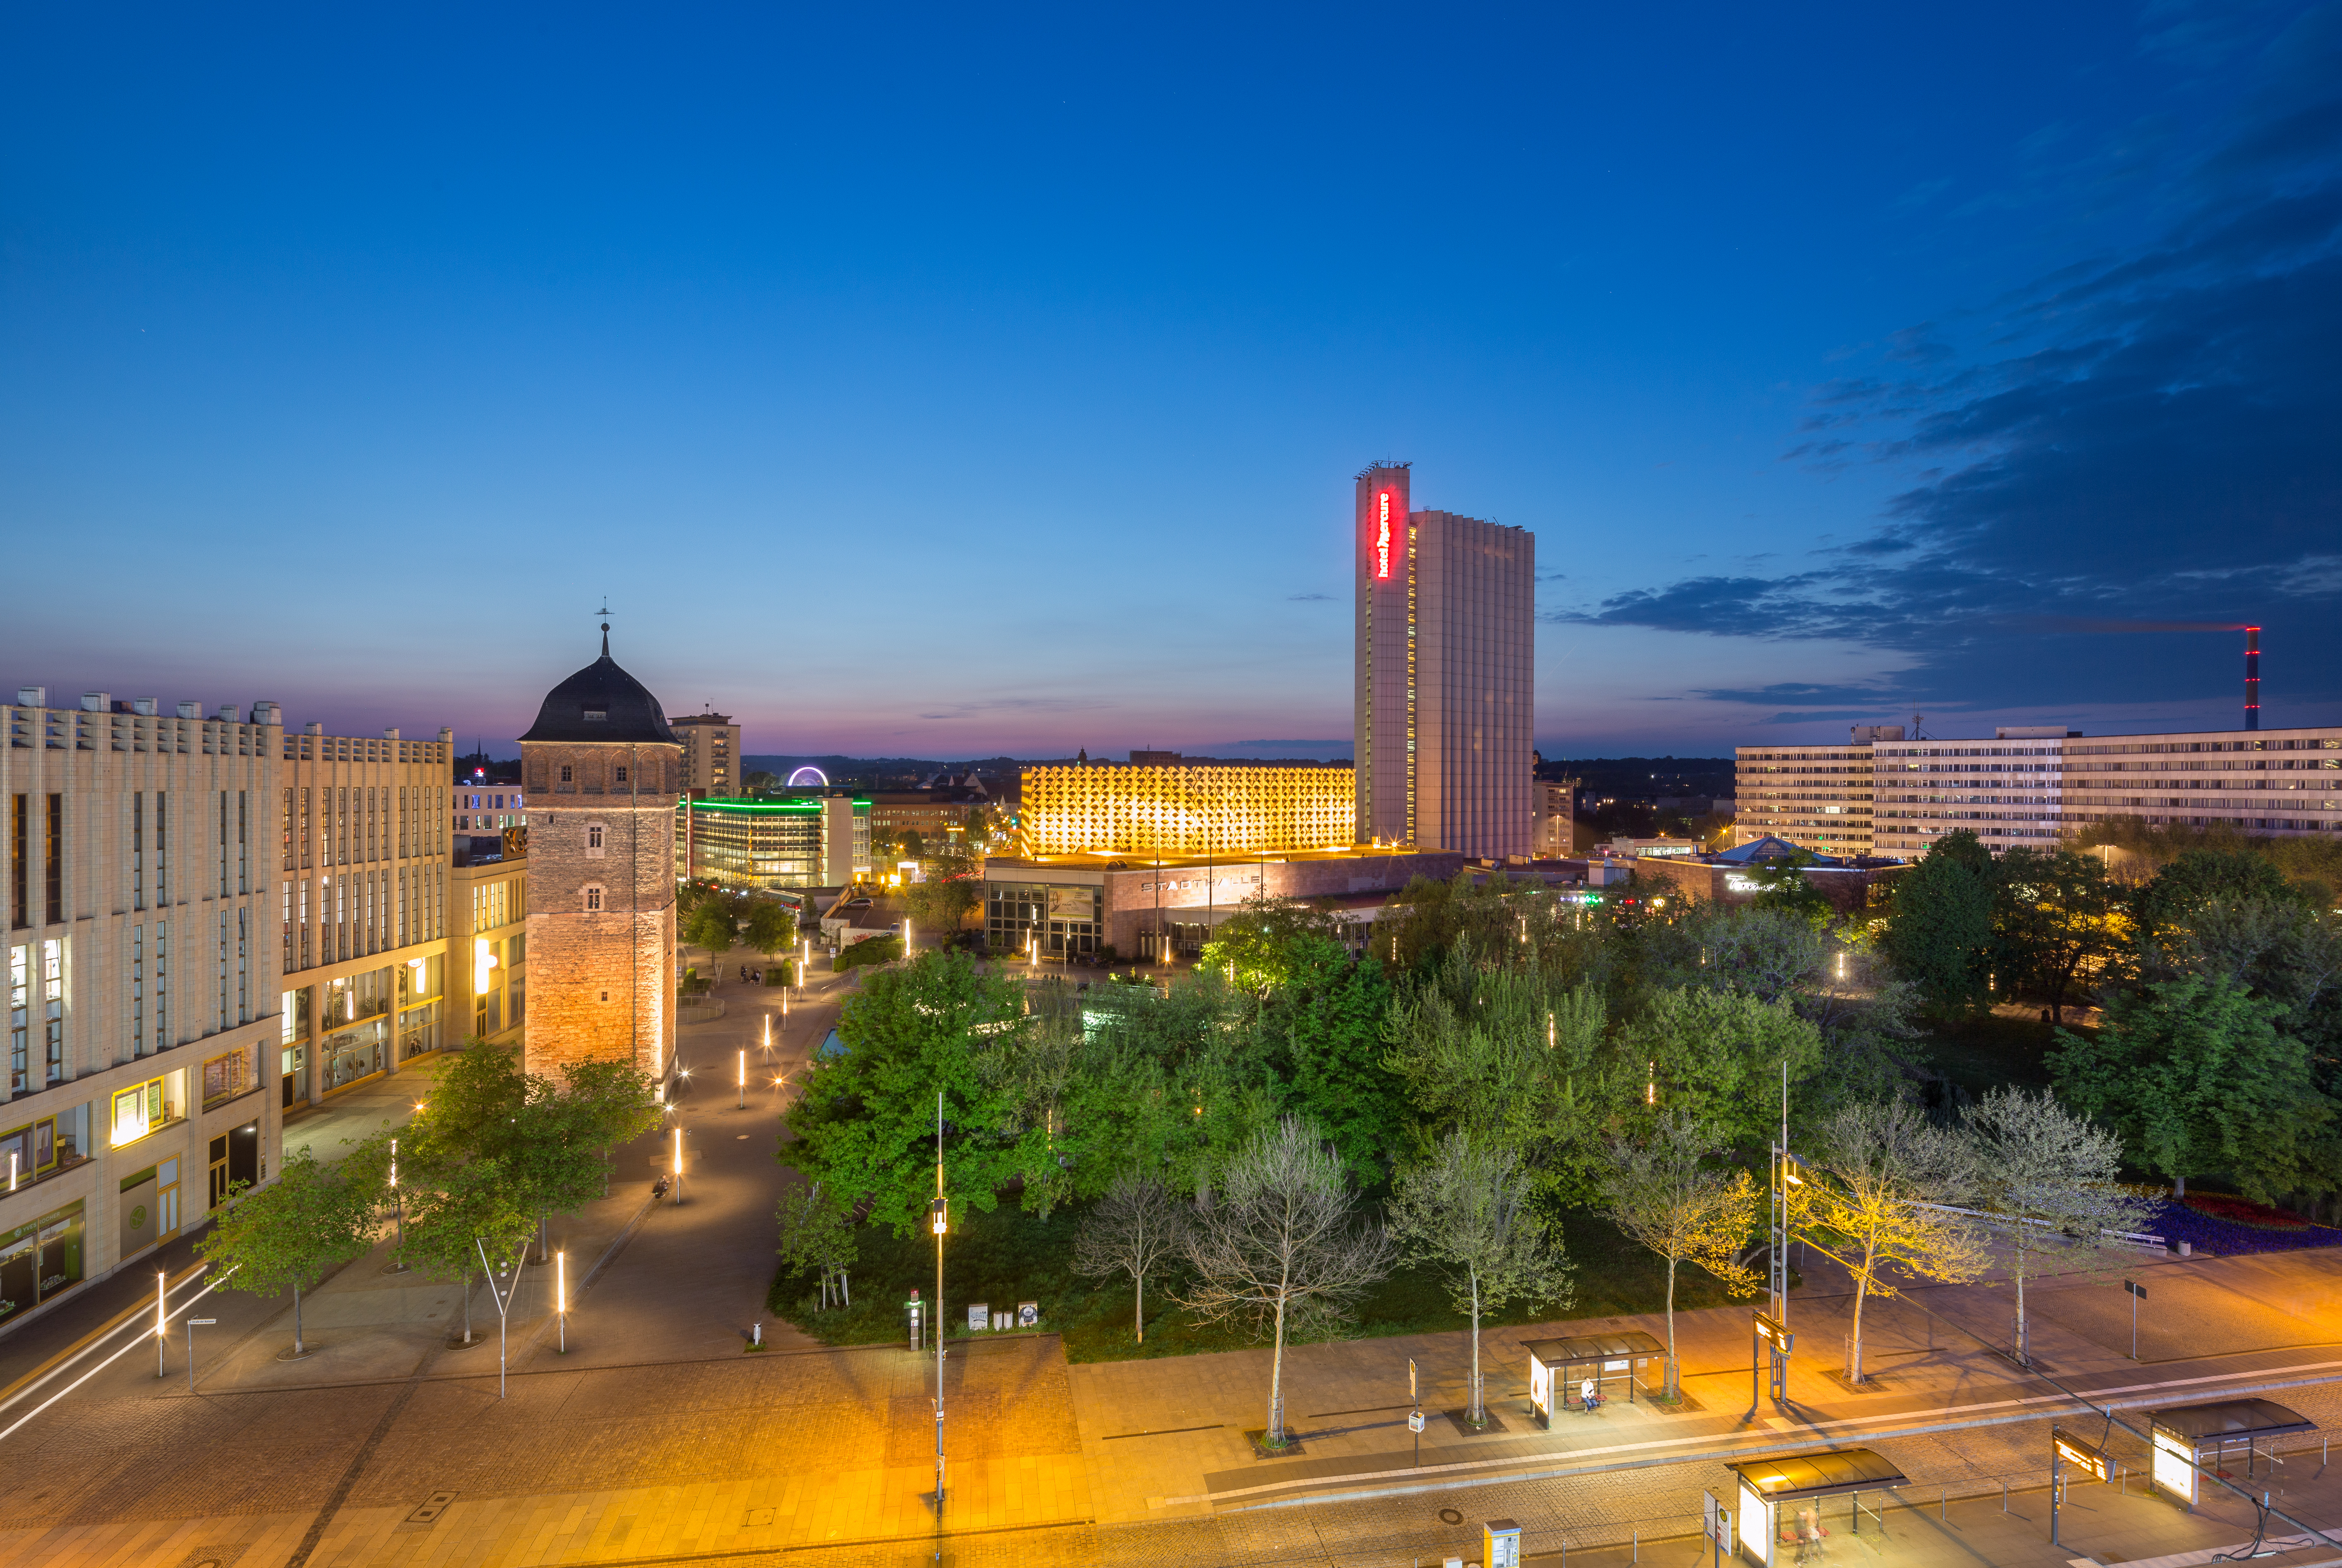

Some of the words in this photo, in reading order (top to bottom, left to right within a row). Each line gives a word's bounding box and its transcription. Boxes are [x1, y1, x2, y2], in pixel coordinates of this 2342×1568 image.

[1378, 548, 1388, 578] hotel
[1141, 876, 1260, 892] STADTHALLE
[23, 1222, 37, 1232] YVES
[39, 1212, 60, 1224] ROCHER
